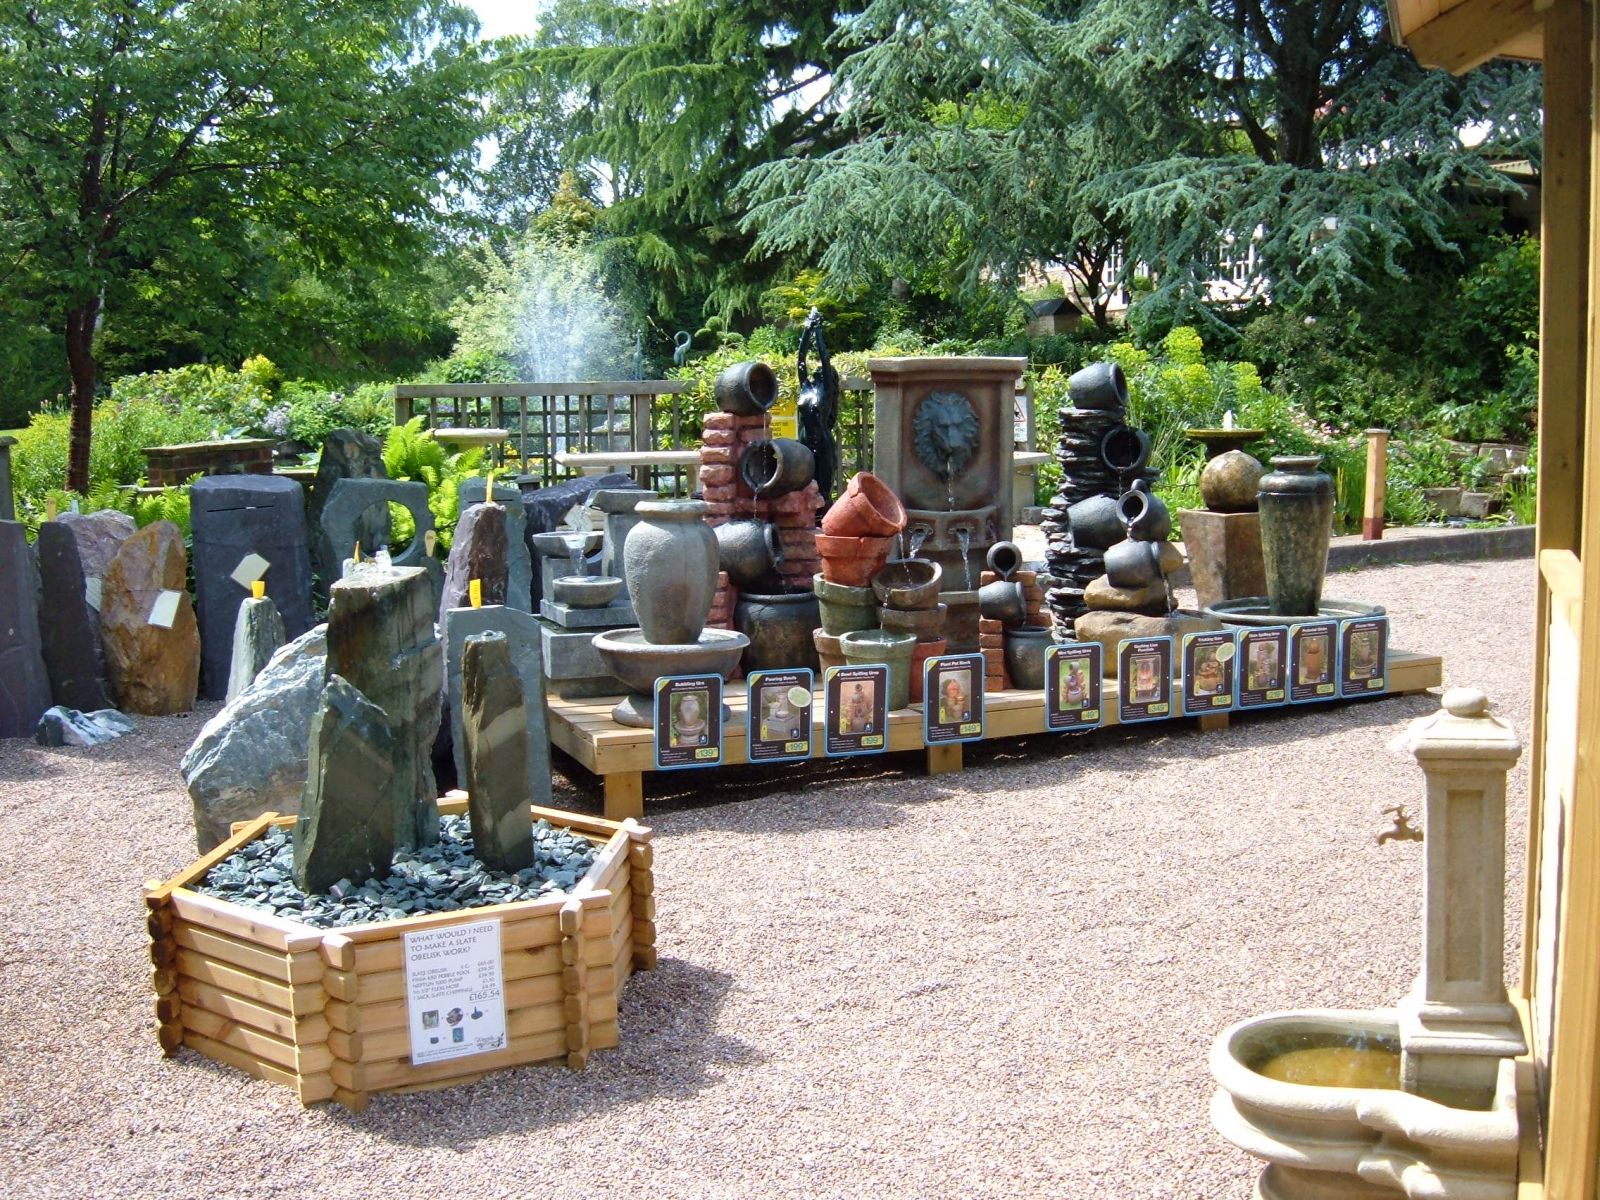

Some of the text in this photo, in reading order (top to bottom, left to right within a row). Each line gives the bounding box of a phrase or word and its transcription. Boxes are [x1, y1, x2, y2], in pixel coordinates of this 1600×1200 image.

[410, 934, 433, 943] WHAT
[437, 929, 467, 939] WOULD
[473, 925, 493, 934] NEED
[410, 944, 423, 952] TO
[424, 941, 446, 950] MAKE
[456, 936, 477, 946] SLATE
[410, 946, 471, 961] OBELISK WORK?
[469, 990, 500, 1001] £165.54
